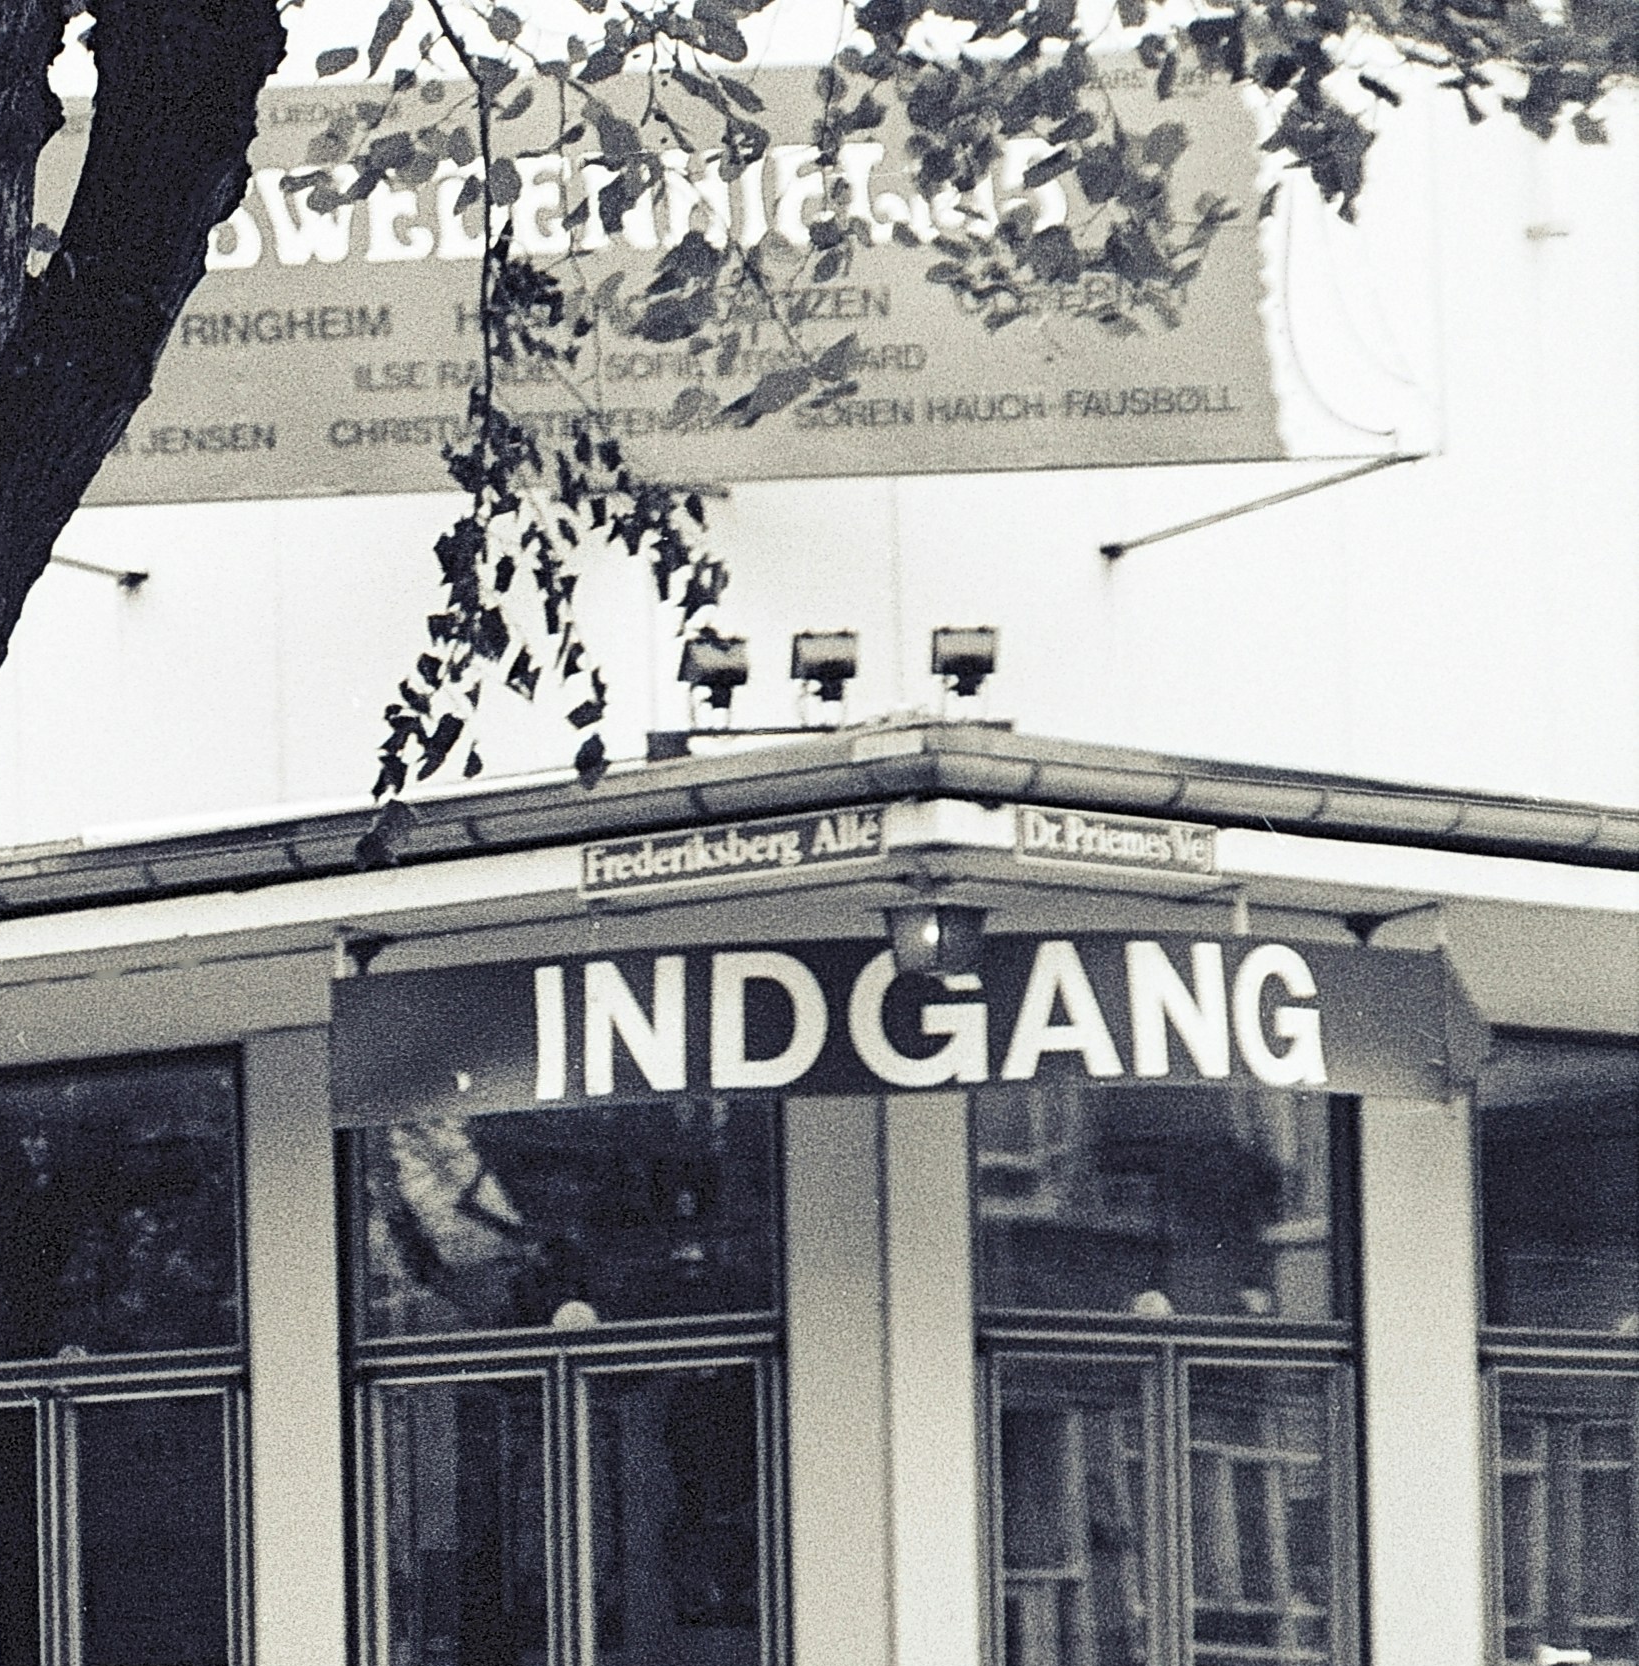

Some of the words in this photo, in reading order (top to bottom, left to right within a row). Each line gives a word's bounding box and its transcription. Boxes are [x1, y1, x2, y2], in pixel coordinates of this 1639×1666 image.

[180, 304, 392, 347] RINGHEIM
[140, 422, 277, 456] JENSEN
[585, 829, 804, 885] Frederiksberg
[811, 812, 880, 856] Allé
[1023, 810, 1065, 848] Dr.
[1066, 813, 1171, 861] Priemes
[1169, 825, 1215, 873] Vej
[533, 939, 1329, 1102] INDGANG
